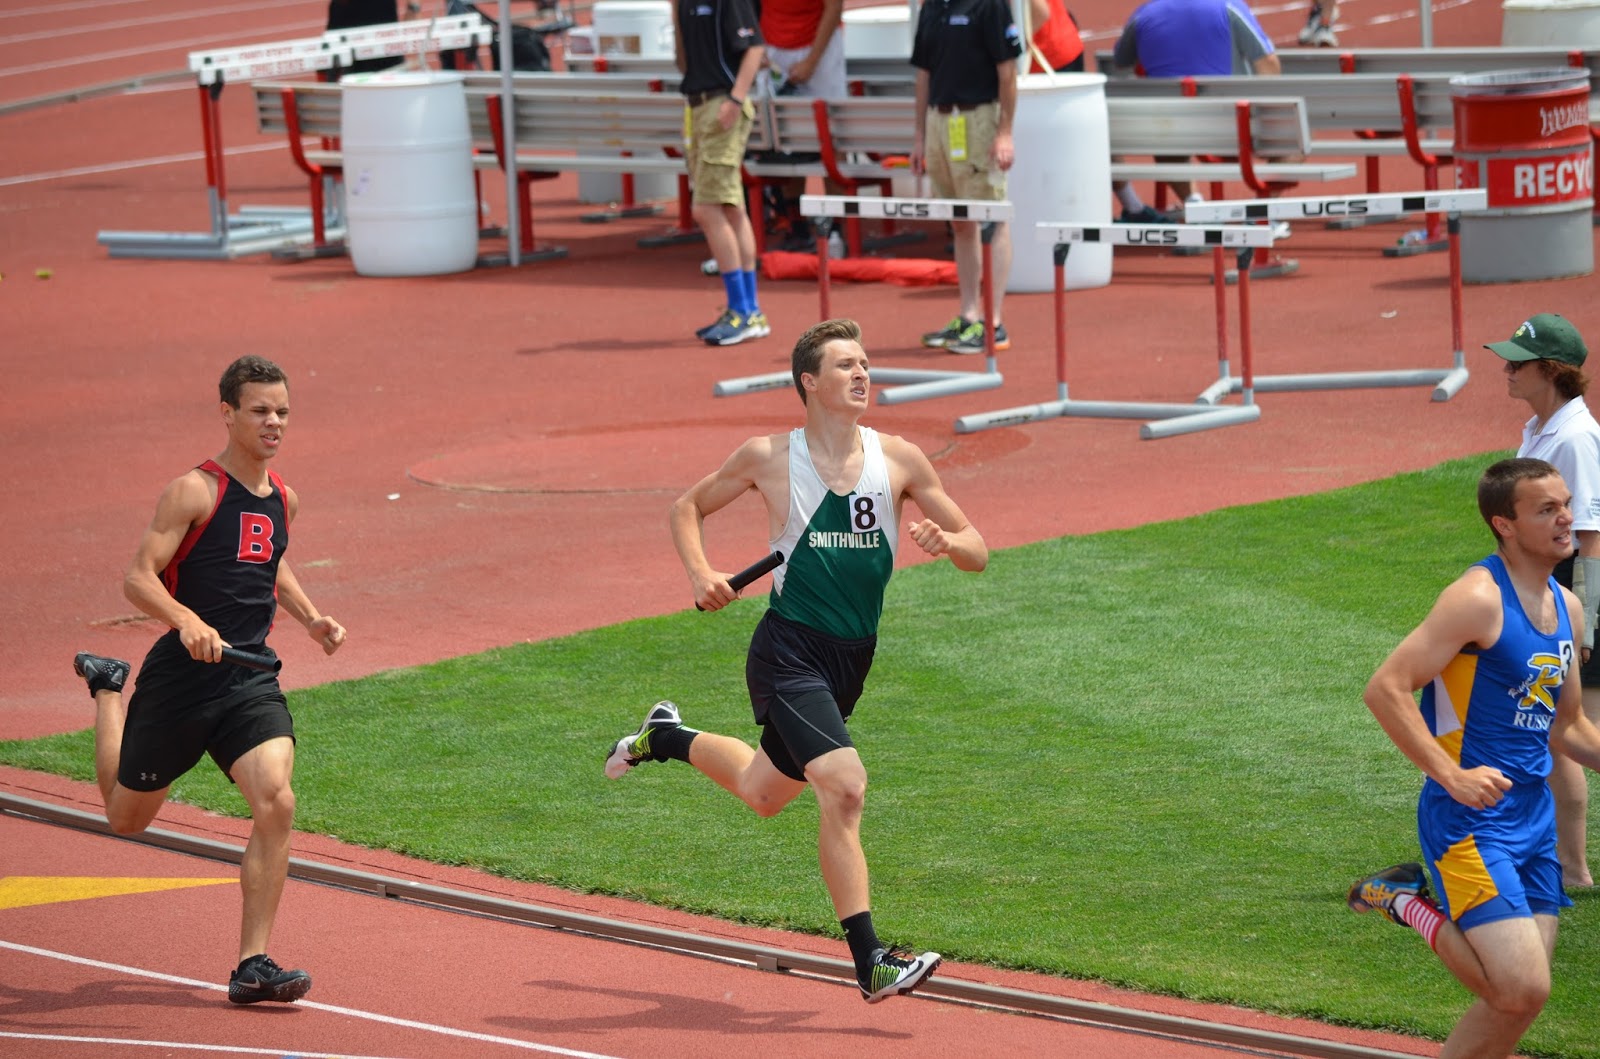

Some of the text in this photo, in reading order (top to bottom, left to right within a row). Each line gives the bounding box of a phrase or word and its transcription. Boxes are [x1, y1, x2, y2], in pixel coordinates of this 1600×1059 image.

[883, 202, 930, 217] UCS
[1302, 200, 1368, 217] UCS
[1126, 229, 1178, 244] UCS
[853, 496, 876, 530] 8
[236, 511, 274, 564] B
[808, 531, 880, 549] SMITHVILLE
